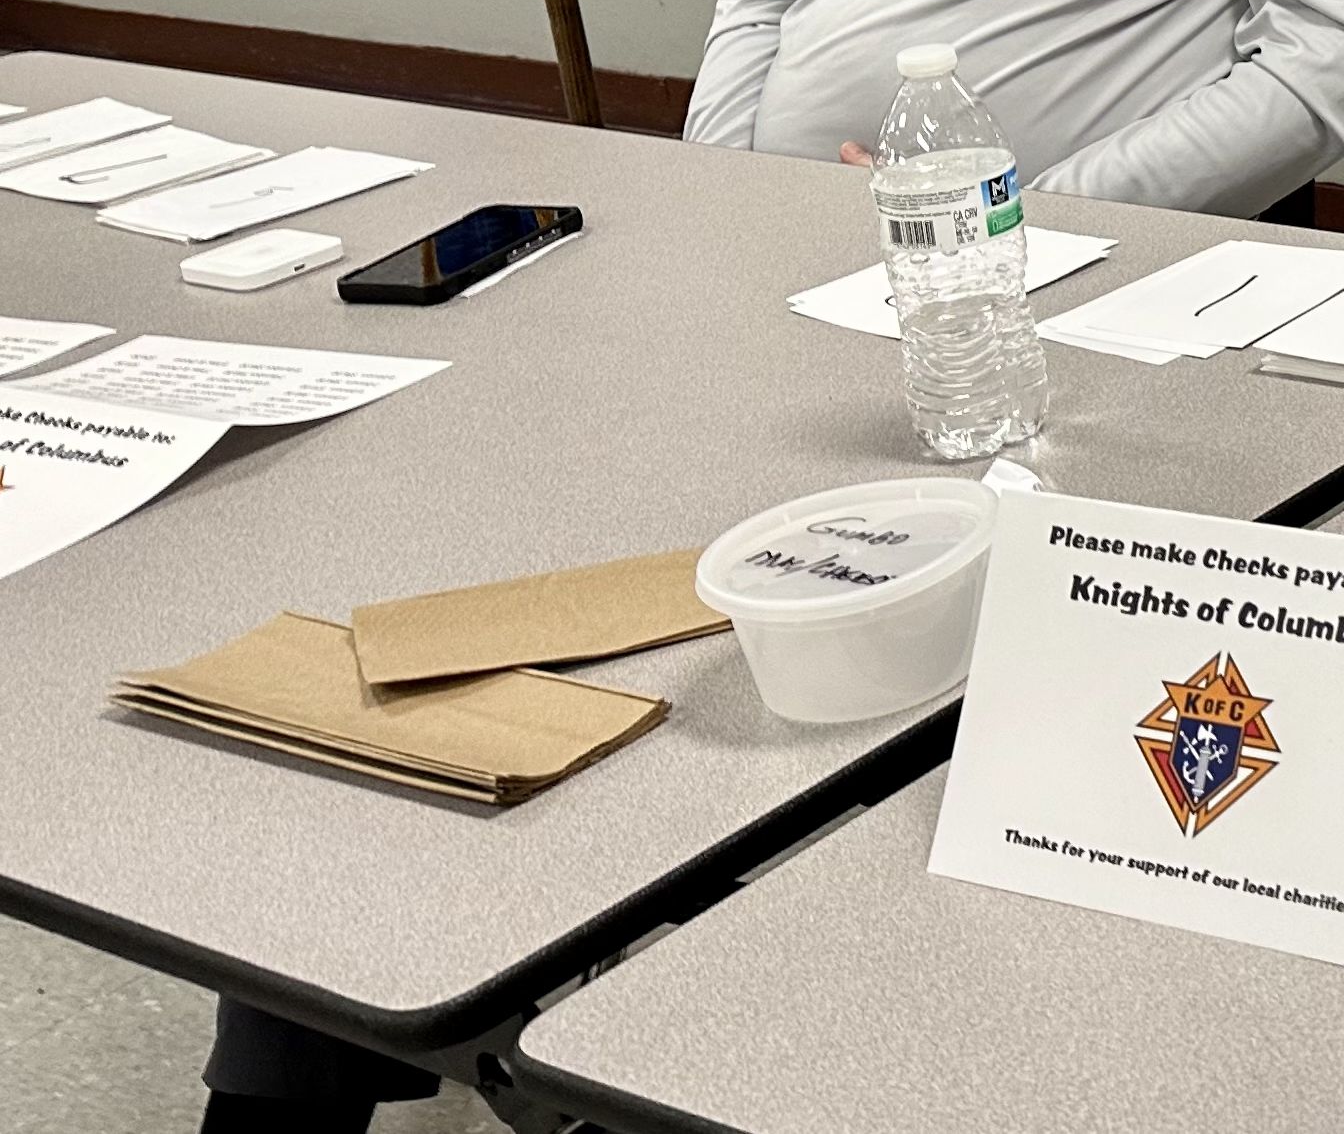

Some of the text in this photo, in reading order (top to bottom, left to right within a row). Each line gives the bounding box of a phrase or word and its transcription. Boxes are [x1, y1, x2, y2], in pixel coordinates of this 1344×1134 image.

[81, 422, 150, 441] payable
[25, 441, 129, 467] Columbus
[1049, 525, 1126, 557] Please
[1130, 540, 1197, 569] make
[1202, 549, 1290, 582] Checks
[1070, 575, 1189, 620] Knights
[1197, 597, 1232, 626] of
[1185, 692, 1245, 723] K OF C
[1004, 829, 1059, 855] Thanks
[1061, 839, 1085, 859] for
[1088, 849, 1125, 869] your
[1127, 855, 1190, 886] support
[1192, 867, 1210, 886] of
[1212, 874, 1240, 892] our
[1242, 878, 1282, 901] local
